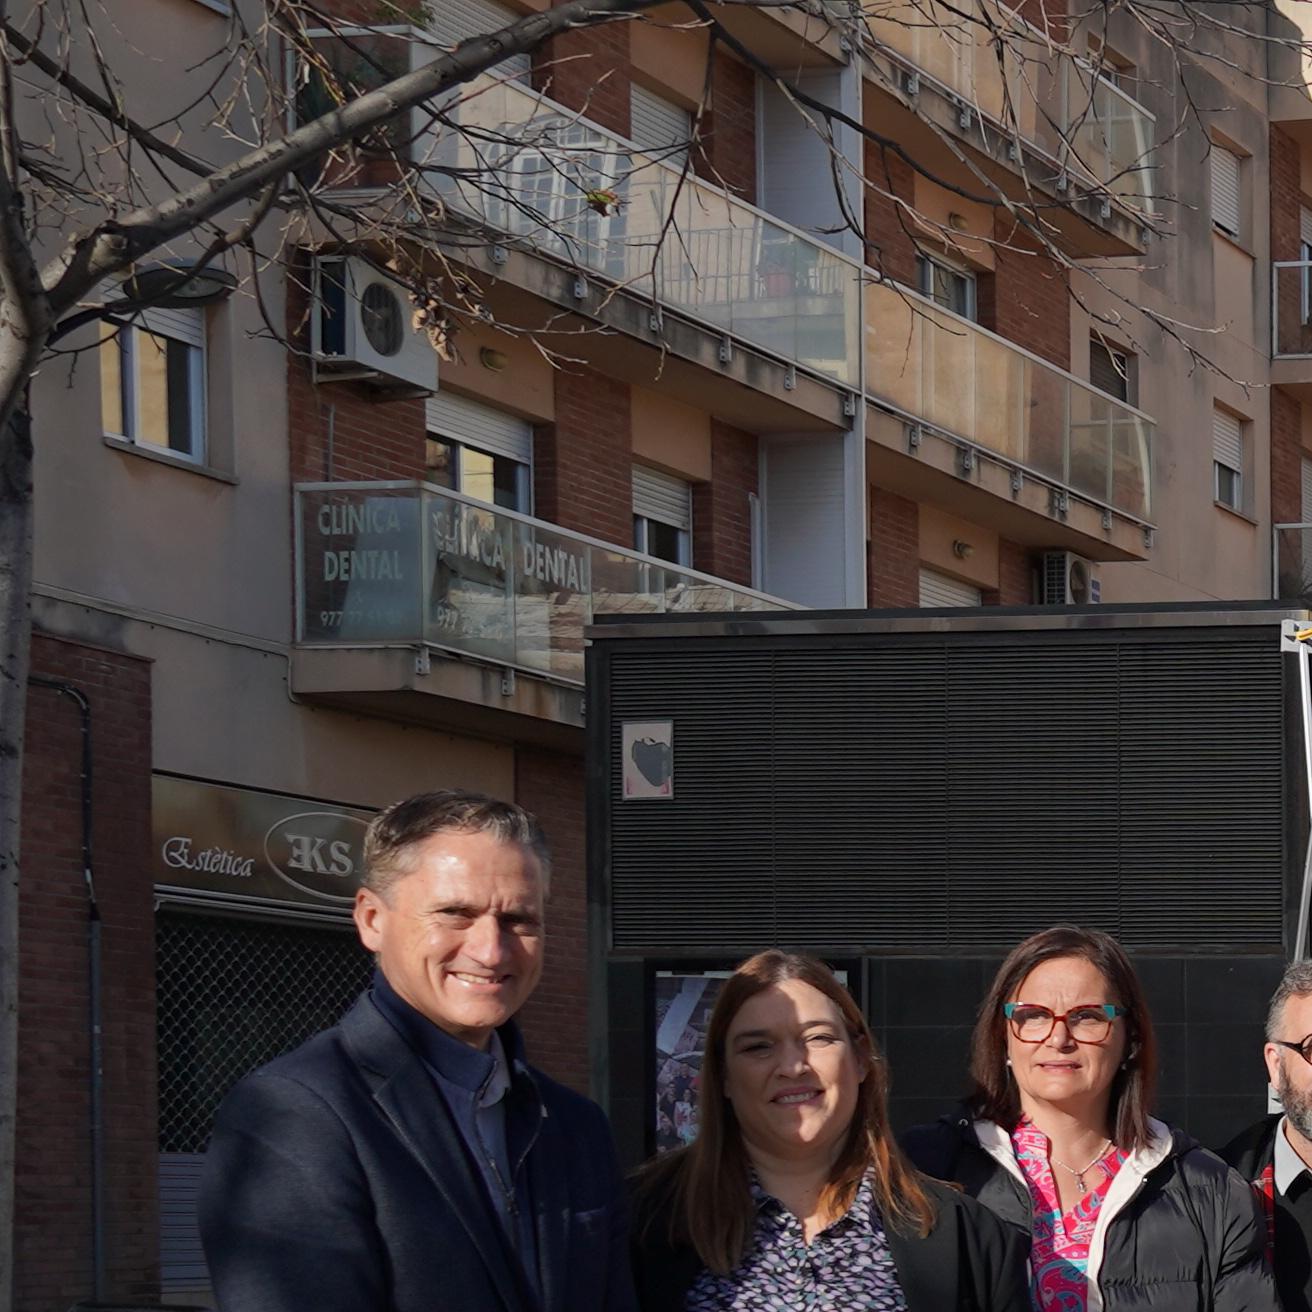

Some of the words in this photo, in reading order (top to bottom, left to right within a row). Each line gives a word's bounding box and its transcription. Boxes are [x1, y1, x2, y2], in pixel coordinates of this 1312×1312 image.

[323, 549, 404, 582] DENTAL
[522, 541, 588, 593] DENTAL
[161, 836, 256, 877] Estètica
